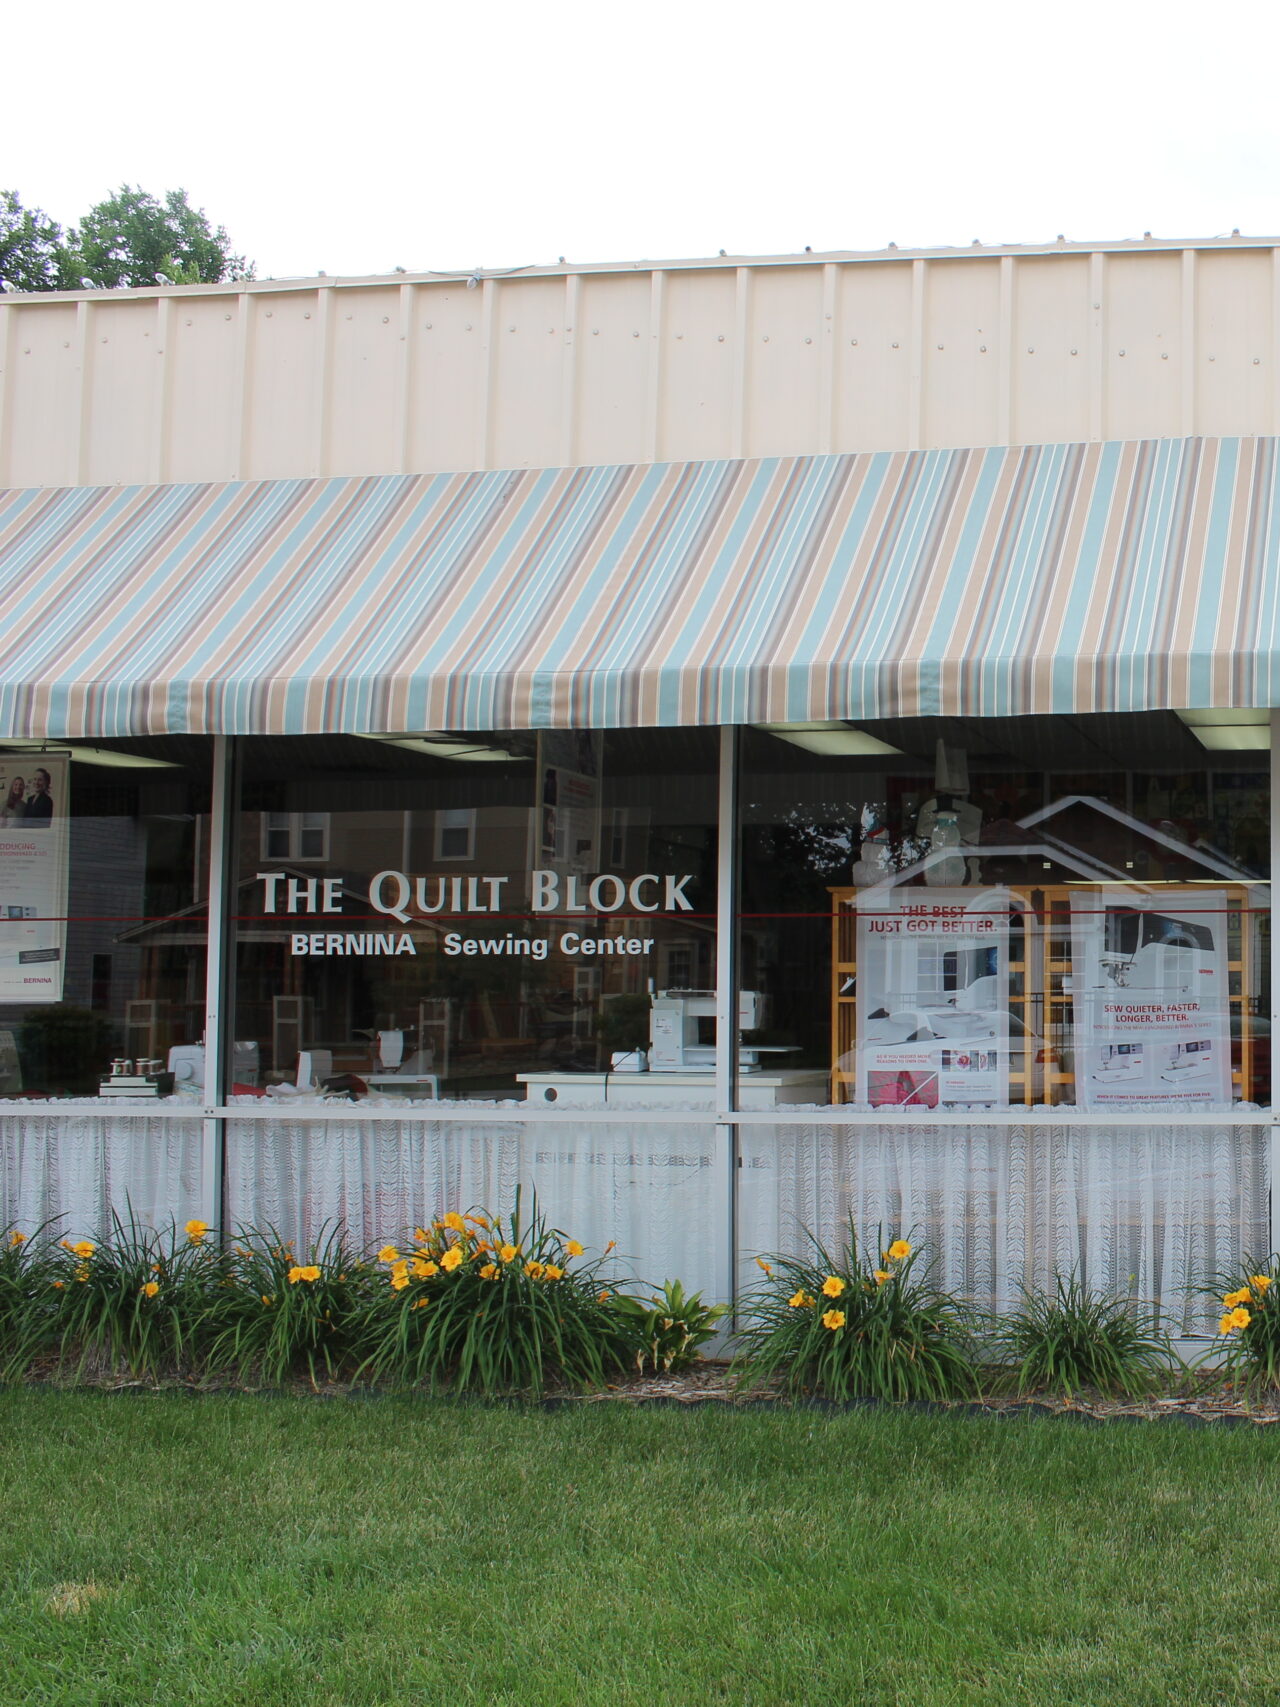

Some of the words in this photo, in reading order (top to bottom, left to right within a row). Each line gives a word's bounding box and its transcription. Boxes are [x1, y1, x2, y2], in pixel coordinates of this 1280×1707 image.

[256, 872, 343, 913] THE
[368, 870, 509, 924] QUILT
[531, 870, 694, 912] BLOCK
[900, 905, 927, 917] THE
[932, 906, 967, 918] BEST
[868, 920, 902, 933] JUST
[906, 920, 937, 932] GOT
[942, 920, 998, 933] BETTER.
[291, 933, 417, 956] BERNINA
[444, 933, 548, 961] Sewing
[560, 932, 655, 955] Center
[1104, 1005, 1123, 1013] SEW
[1125, 1004, 1164, 1014] QUIETER,
[1167, 1003, 1200, 1012] FASTER,
[1116, 1014, 1153, 1024] LONGER,
[1156, 1013, 1189, 1022] BETTER.
